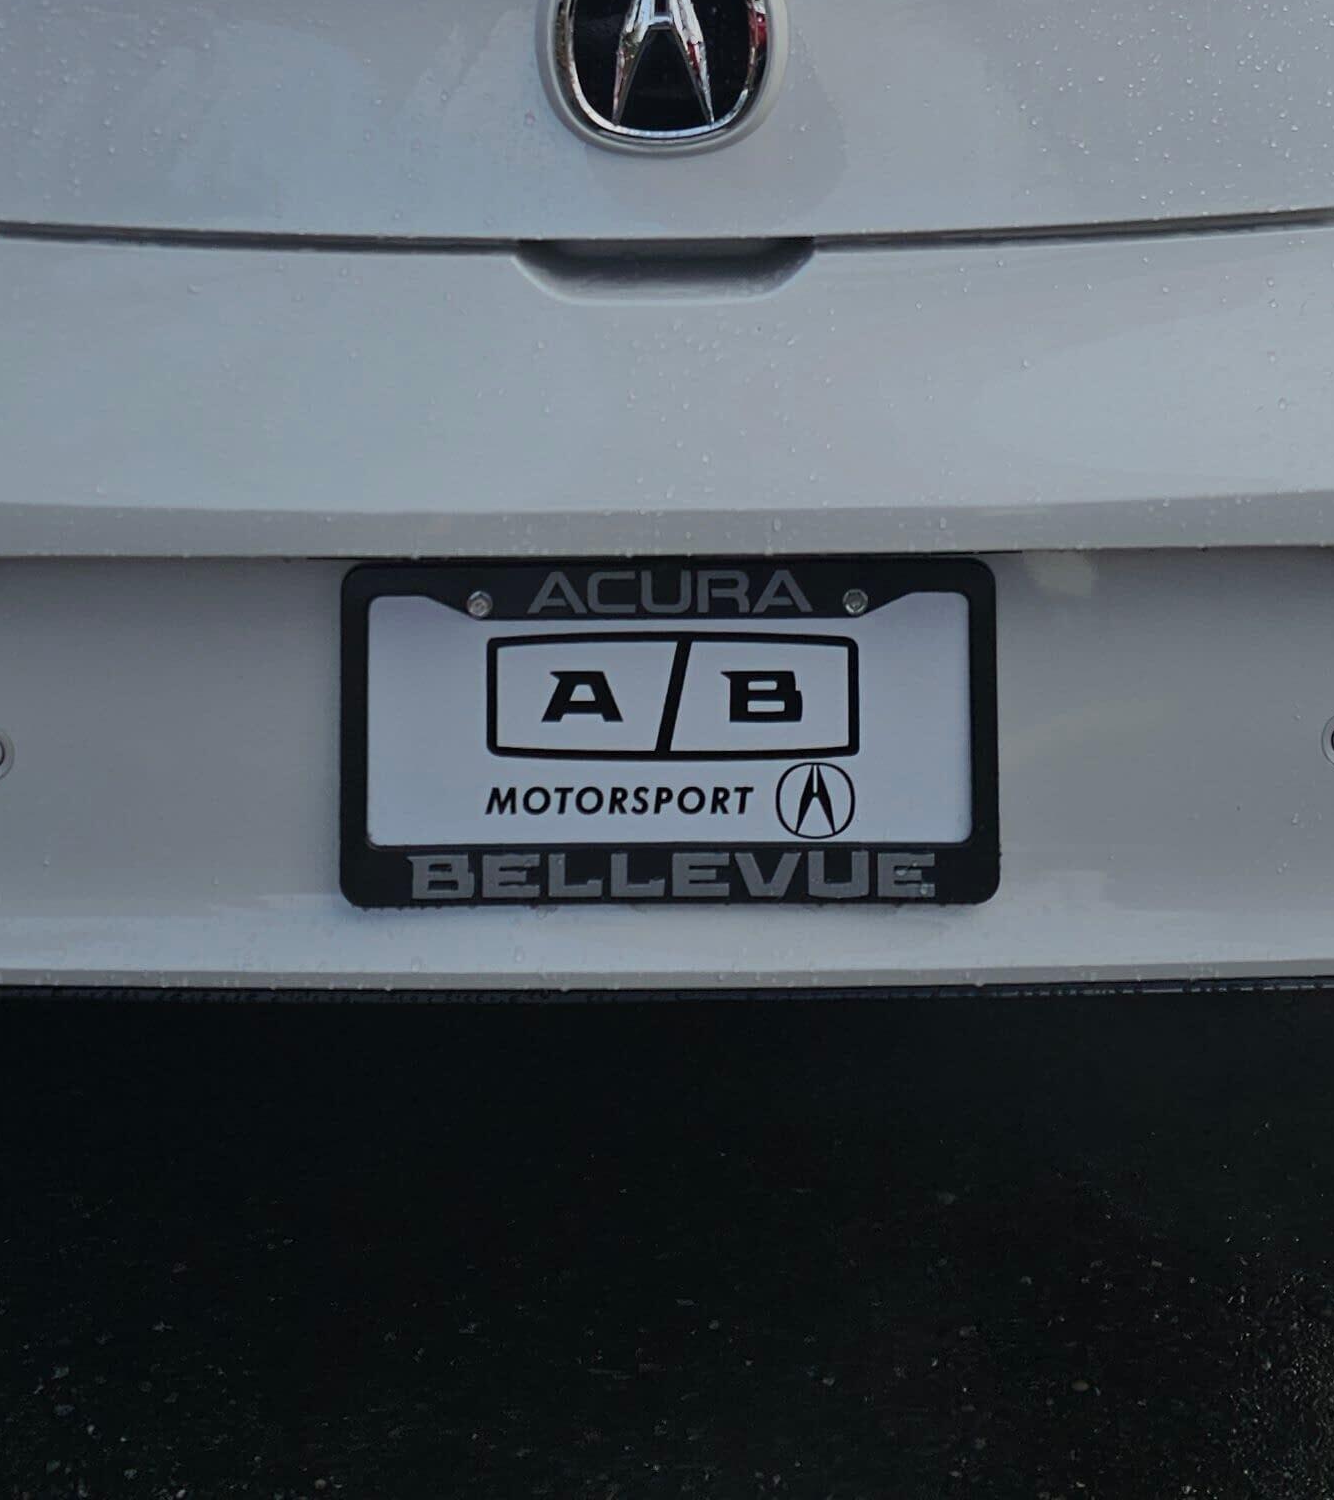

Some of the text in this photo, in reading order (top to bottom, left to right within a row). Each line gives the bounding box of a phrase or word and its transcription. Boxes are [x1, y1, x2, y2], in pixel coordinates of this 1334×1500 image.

[527, 570, 813, 614] ACURA
[486, 785, 754, 816] MOTORSPORT
[407, 852, 936, 900] BELLEVUE
